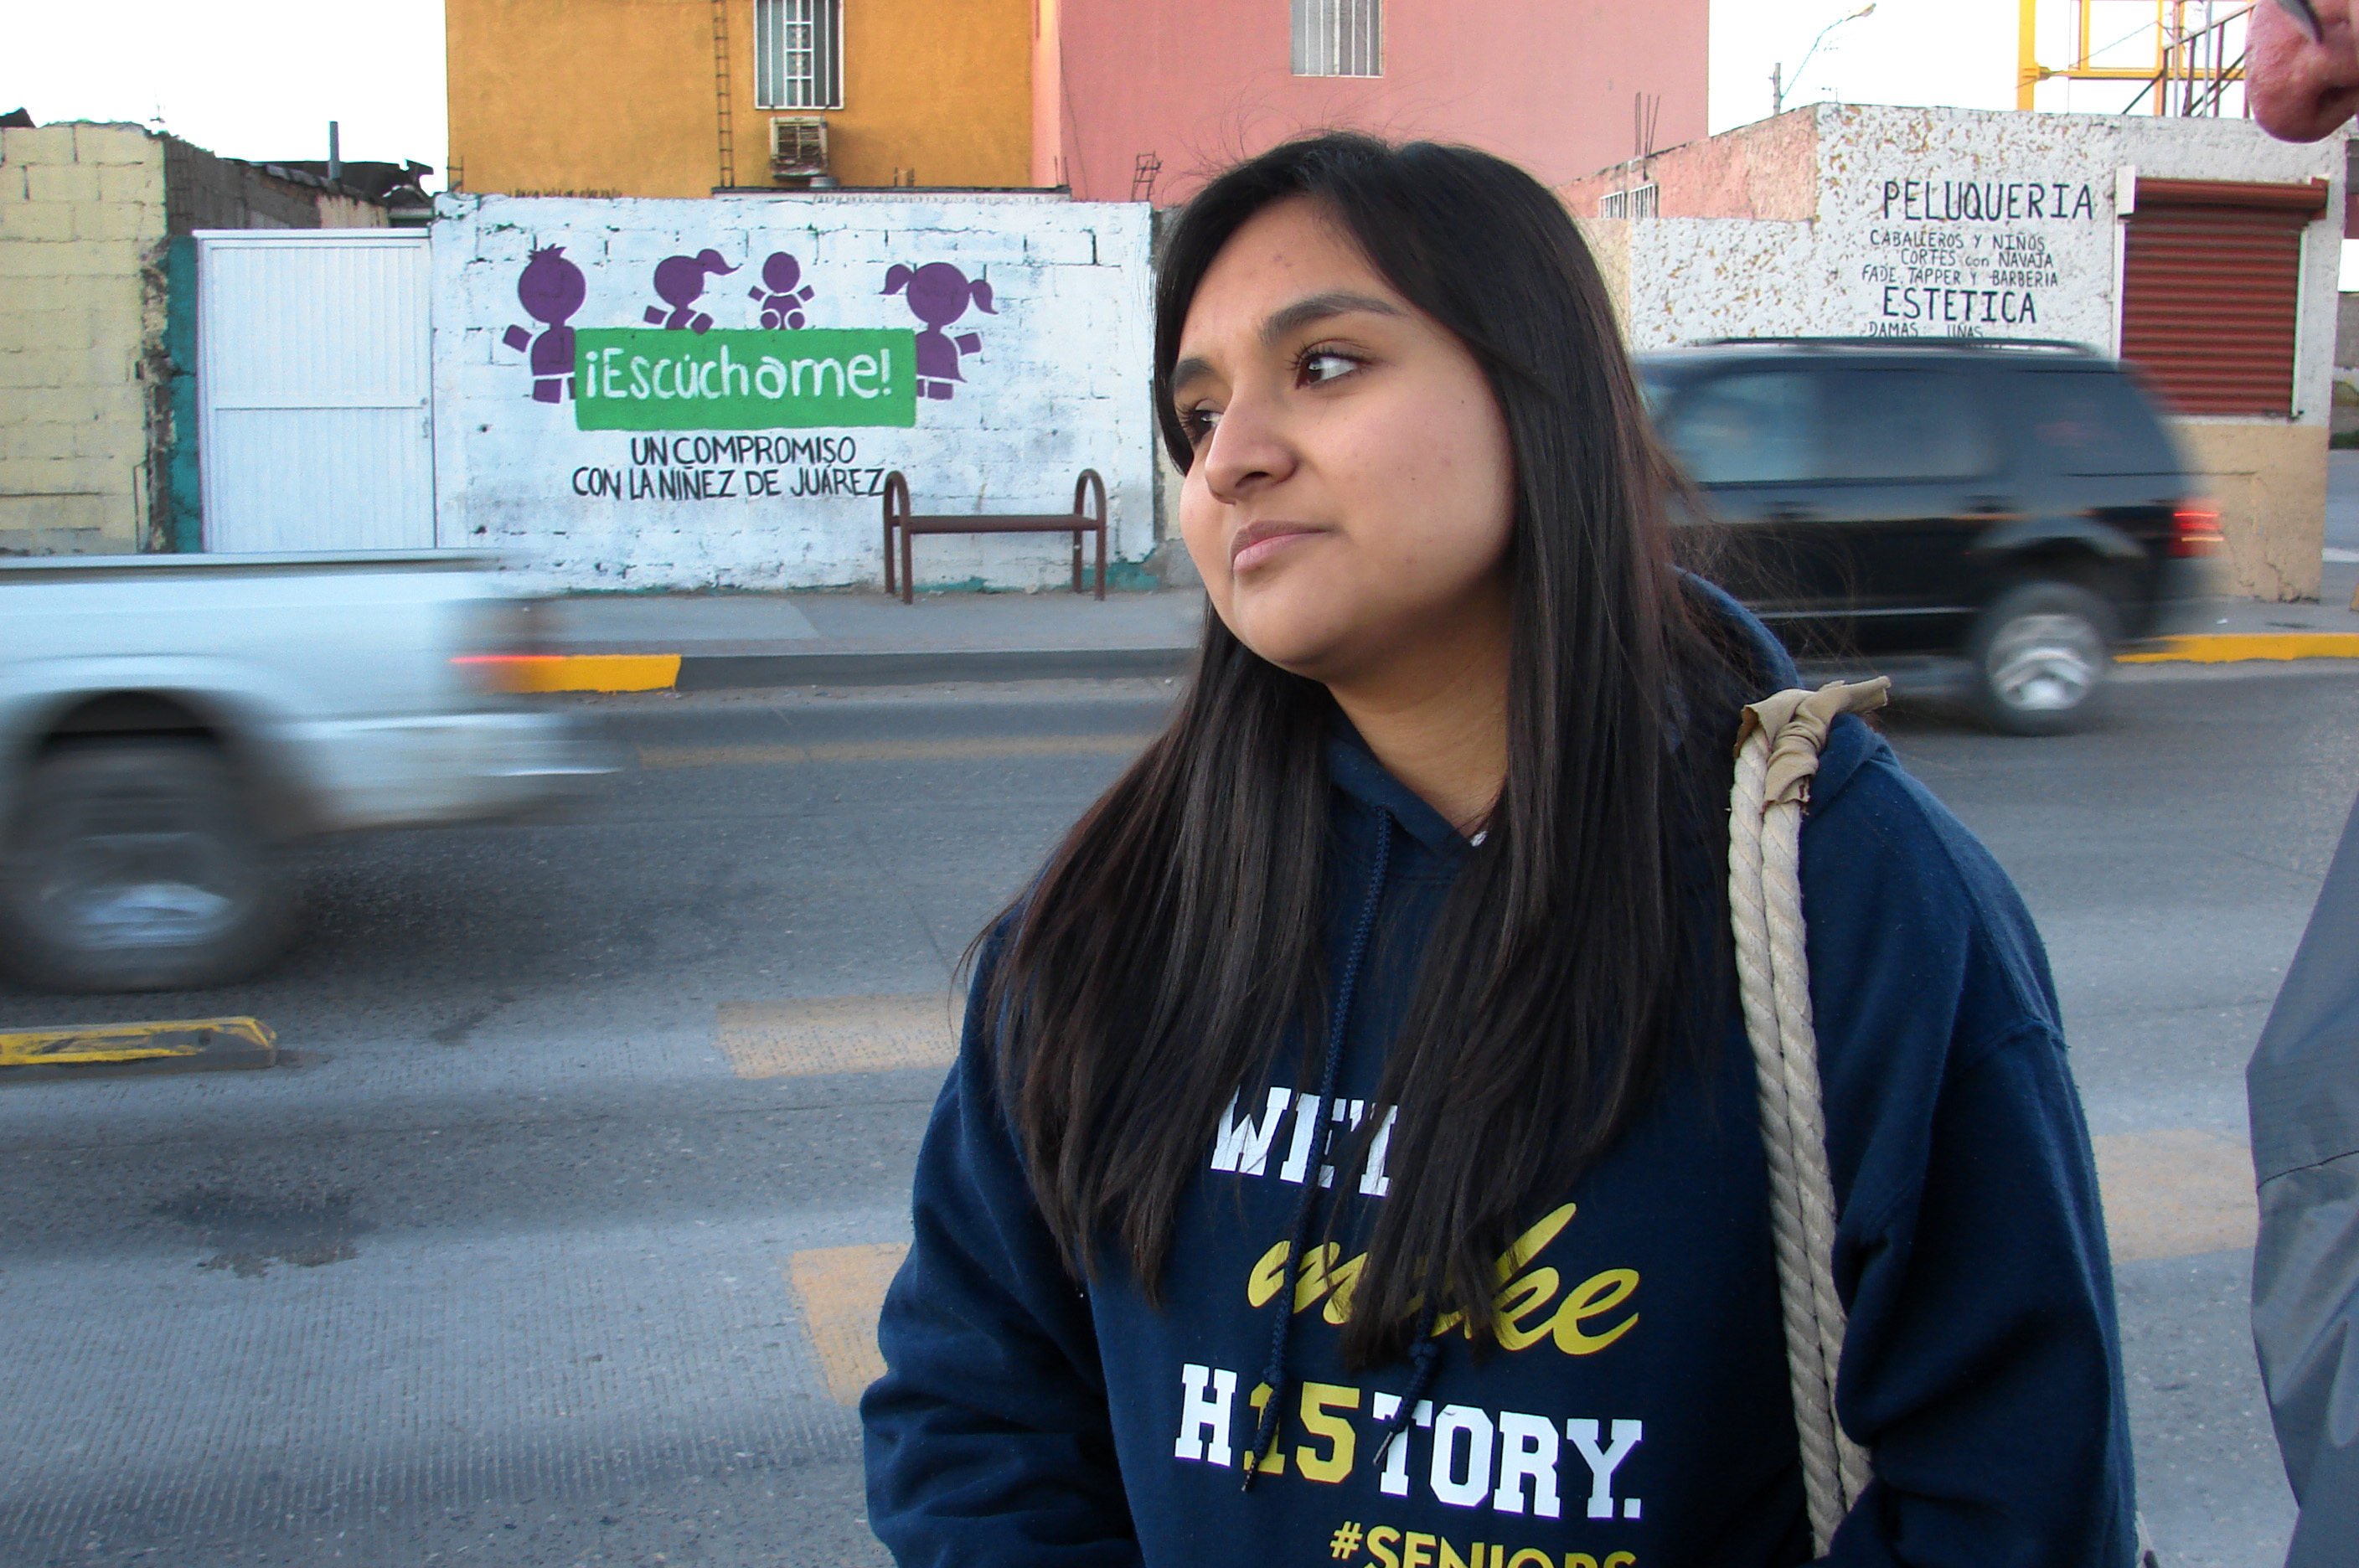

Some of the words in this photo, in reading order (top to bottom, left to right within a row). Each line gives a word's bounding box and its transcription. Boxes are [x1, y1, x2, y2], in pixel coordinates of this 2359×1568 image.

[1883, 180, 2094, 221] PELUQUERIA
[1870, 229, 1964, 250] CABALLEROS
[1974, 233, 1983, 249] Y
[1992, 231, 2046, 252] NIÑOS
[1900, 247, 1956, 266] CORTES
[1964, 255, 1990, 268] con
[1998, 251, 2054, 269] NAVAJA
[1907, 266, 1961, 286] TAPPER
[1969, 271, 1978, 286] Y
[1990, 270, 2058, 287] BARBERIA
[1882, 285, 2037, 324] ESTETICA
[1869, 321, 1919, 337] DAMAS
[585, 343, 892, 400] ¡Escúchame!
[631, 436, 668, 466] UN
[673, 434, 856, 466] COMPROMISO
[572, 465, 622, 501] CON
[629, 468, 653, 500] LA
[659, 465, 736, 501] NIÑEZ
[746, 469, 782, 497] DE
[790, 463, 885, 497] JUÁREZ
[1247, 1202, 1640, 1355] mke
